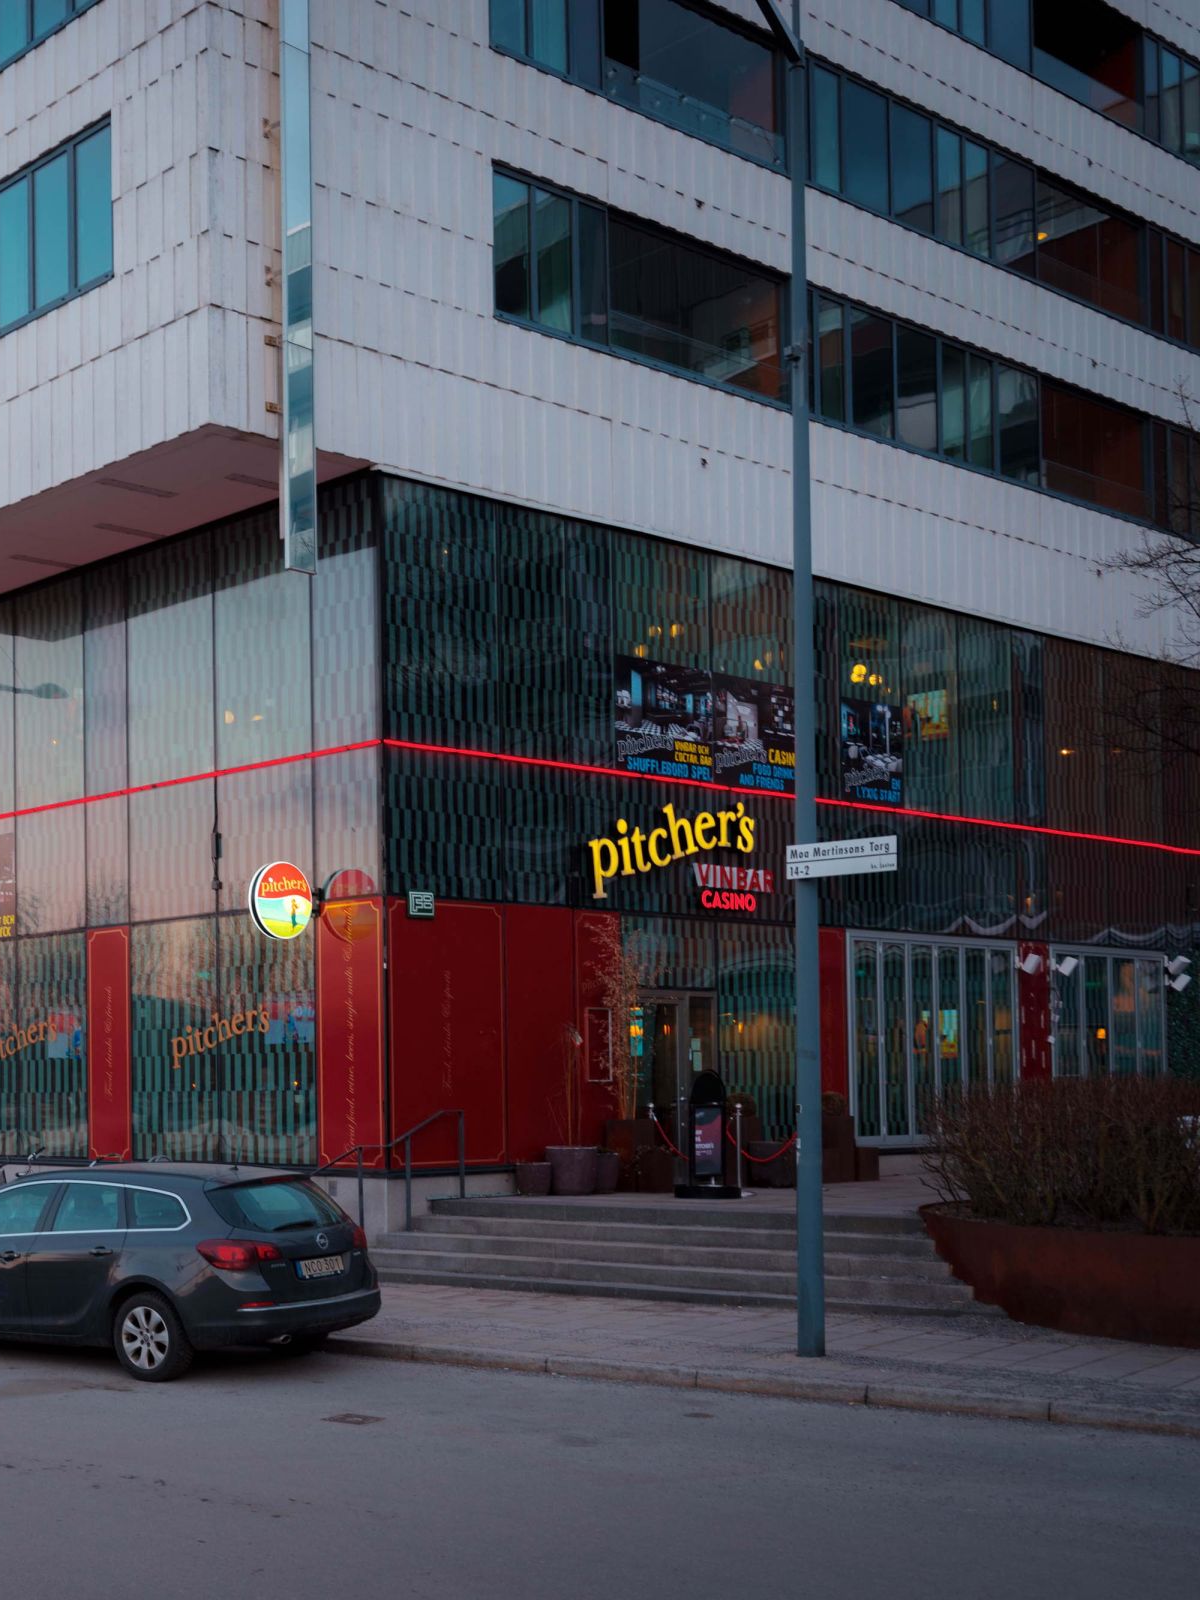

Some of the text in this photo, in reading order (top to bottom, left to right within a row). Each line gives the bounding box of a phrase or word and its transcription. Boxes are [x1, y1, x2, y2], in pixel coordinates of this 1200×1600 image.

[739, 773, 784, 791] AND FRIENDS
[588, 802, 755, 899] pitcher's
[790, 842, 890, 859] Moa Martinsons Torg
[693, 862, 774, 894] VINBAR
[790, 865, 810, 876] 14-2
[701, 890, 756, 912] CASINO
[171, 1003, 270, 1069] pitcher's
